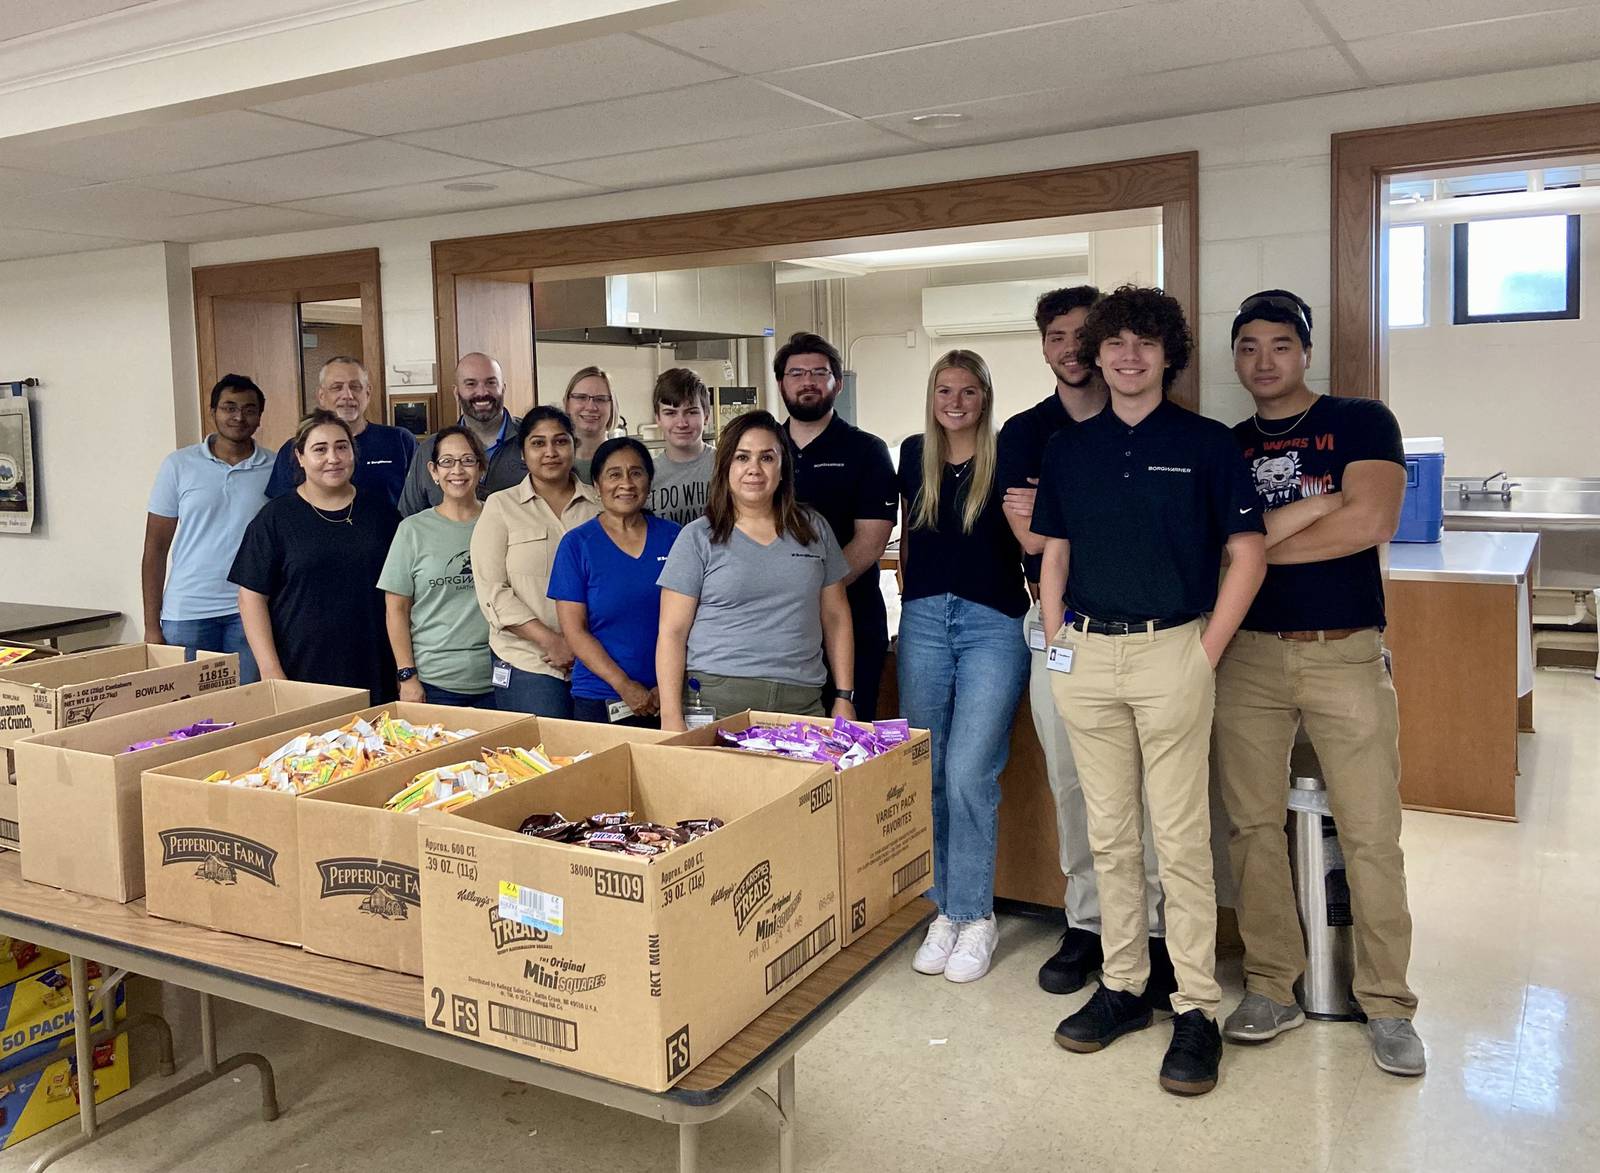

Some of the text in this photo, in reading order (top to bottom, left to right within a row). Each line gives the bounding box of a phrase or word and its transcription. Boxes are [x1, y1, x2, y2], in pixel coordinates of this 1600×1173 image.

[651, 489, 656, 511] I
[660, 485, 679, 510] DO
[200, 668, 229, 682] 11815
[135, 682, 175, 698] BOWLPAK
[8, 716, 32, 730] Crunch
[811, 780, 832, 812] 51109
[876, 795, 914, 825] VARIETY PACK
[882, 811, 912, 837] FAVORITES
[170, 836, 265, 869] PEPPERIDGE FARM
[425, 838, 477, 857] Approx. 600 CT.
[330, 866, 401, 889] PEPPERIDGE
[425, 857, 478, 882] .39 OZ. (11g)
[570, 863, 642, 900] 38000 51109
[661, 866, 682, 884] Approx.
[684, 856, 694, 871] 600
[456, 888, 490, 908] Kellogg's
[661, 871, 705, 908] .39 OZ. (11g)
[710, 883, 735, 906] Kellogg's
[735, 877, 770, 930] TREATS
[853, 902, 865, 929] FS
[755, 915, 777, 942] Mini
[523, 959, 607, 995] Mini SQUARES
[550, 957, 586, 973] Original
[649, 934, 661, 997] RKT MINI
[431, 987, 478, 1032] 2 FS
[532, 998, 548, 1009] Kellogg
[3, 1030, 25, 1051] 50
[668, 1032, 688, 1077] FS
